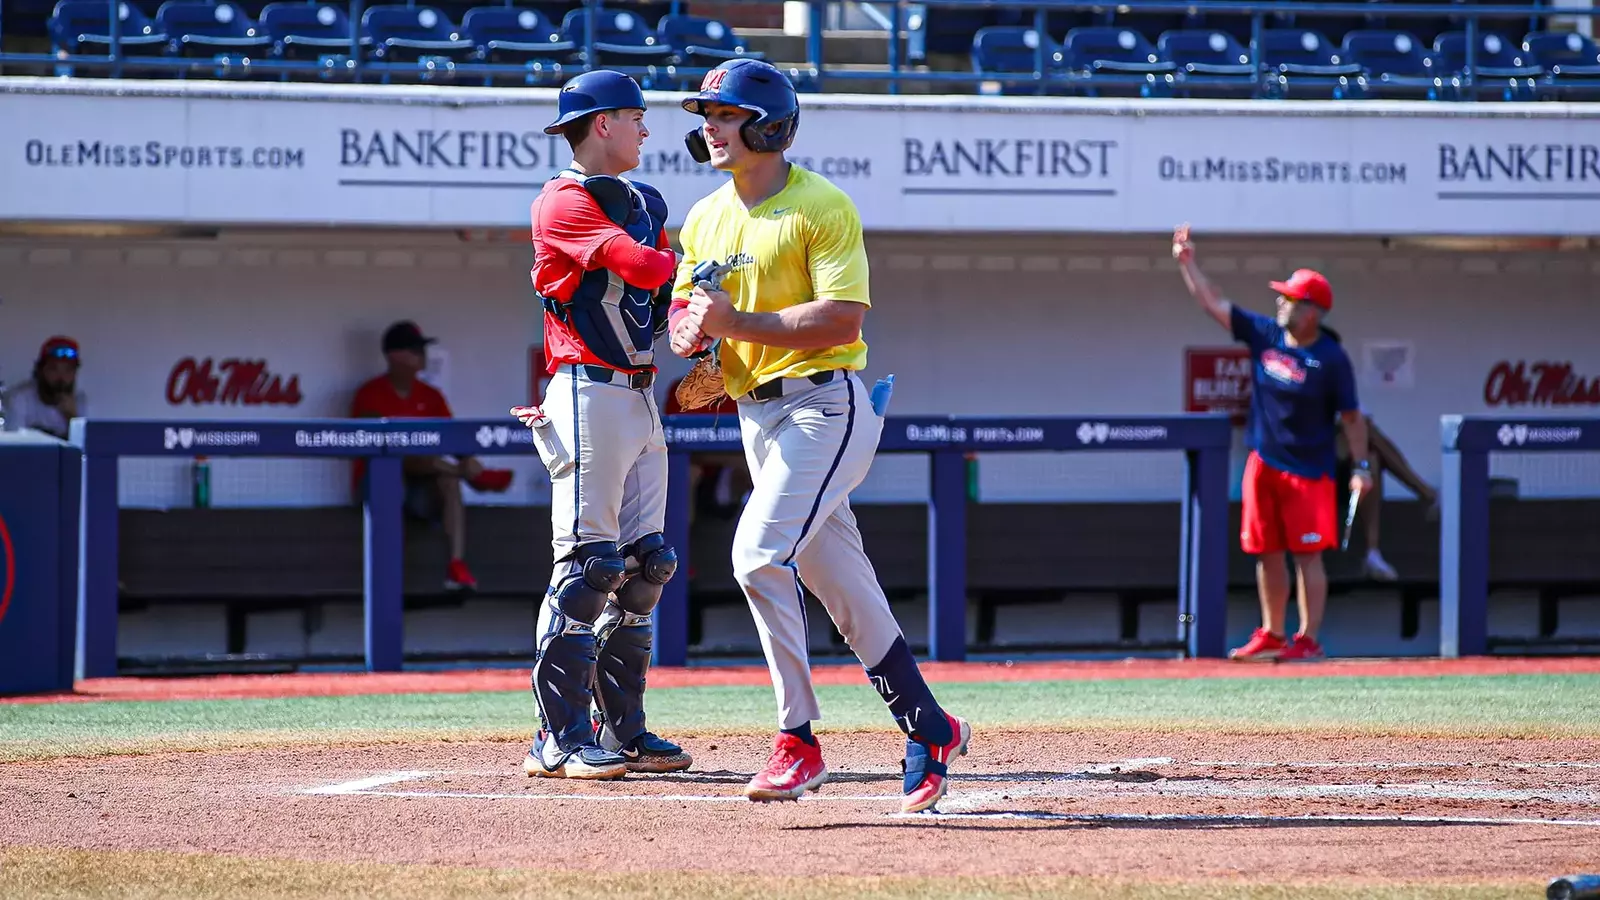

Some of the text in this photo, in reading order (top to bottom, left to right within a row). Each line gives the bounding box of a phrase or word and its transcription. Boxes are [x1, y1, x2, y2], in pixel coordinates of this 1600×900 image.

[340, 128, 562, 171] BANKFIRST
[903, 137, 1118, 177] BANKFIRST
[218, 358, 304, 406] Miss
